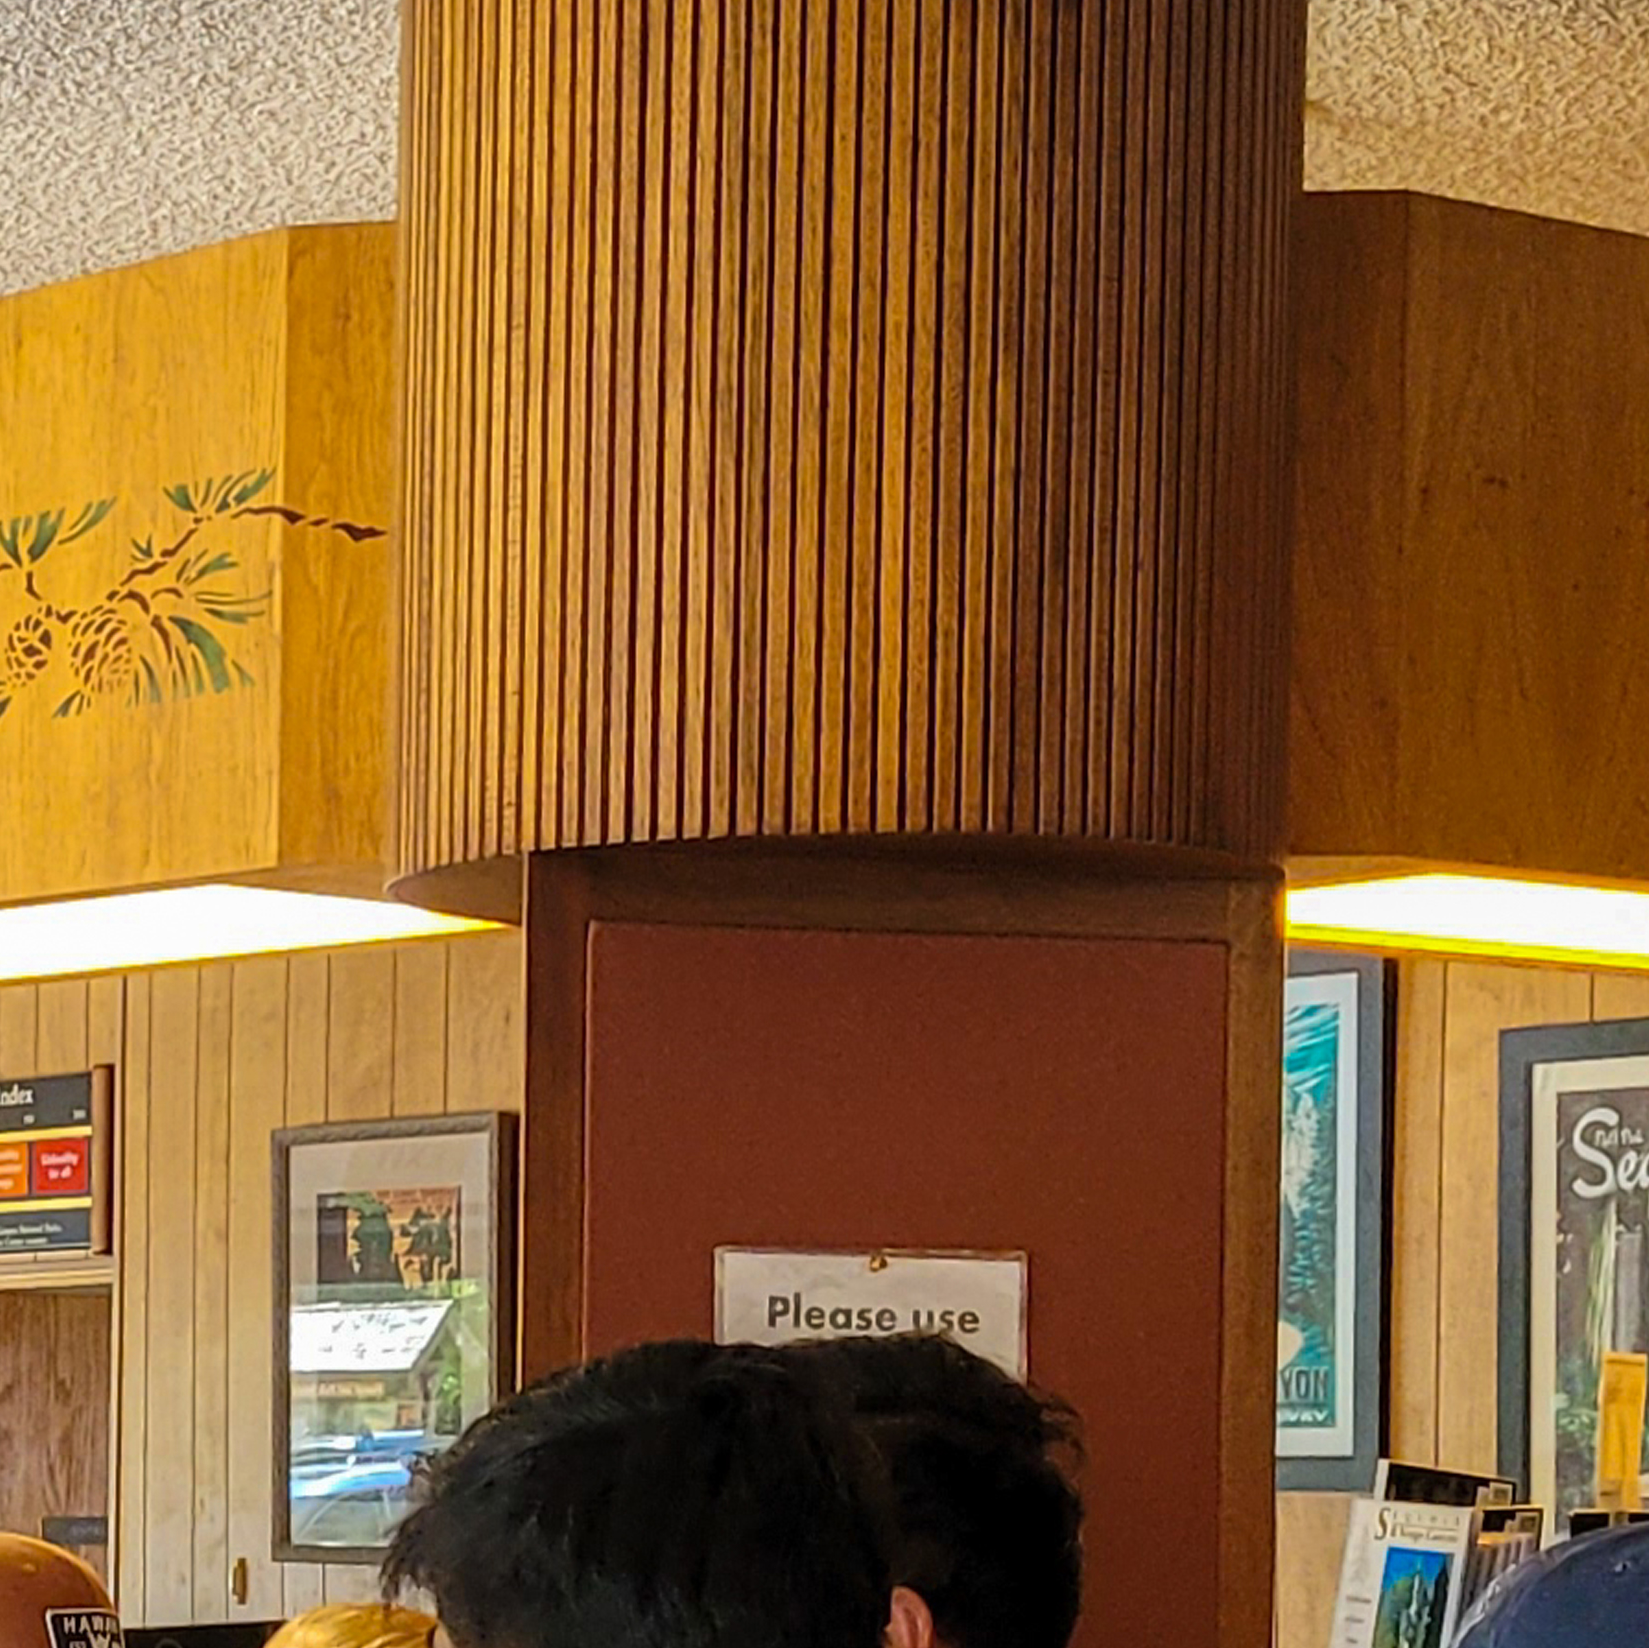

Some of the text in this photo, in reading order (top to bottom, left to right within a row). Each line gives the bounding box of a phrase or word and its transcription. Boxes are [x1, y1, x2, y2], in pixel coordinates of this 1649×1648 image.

[767, 1292, 981, 1335] Please use
[1279, 1369, 1329, 1401] YON
